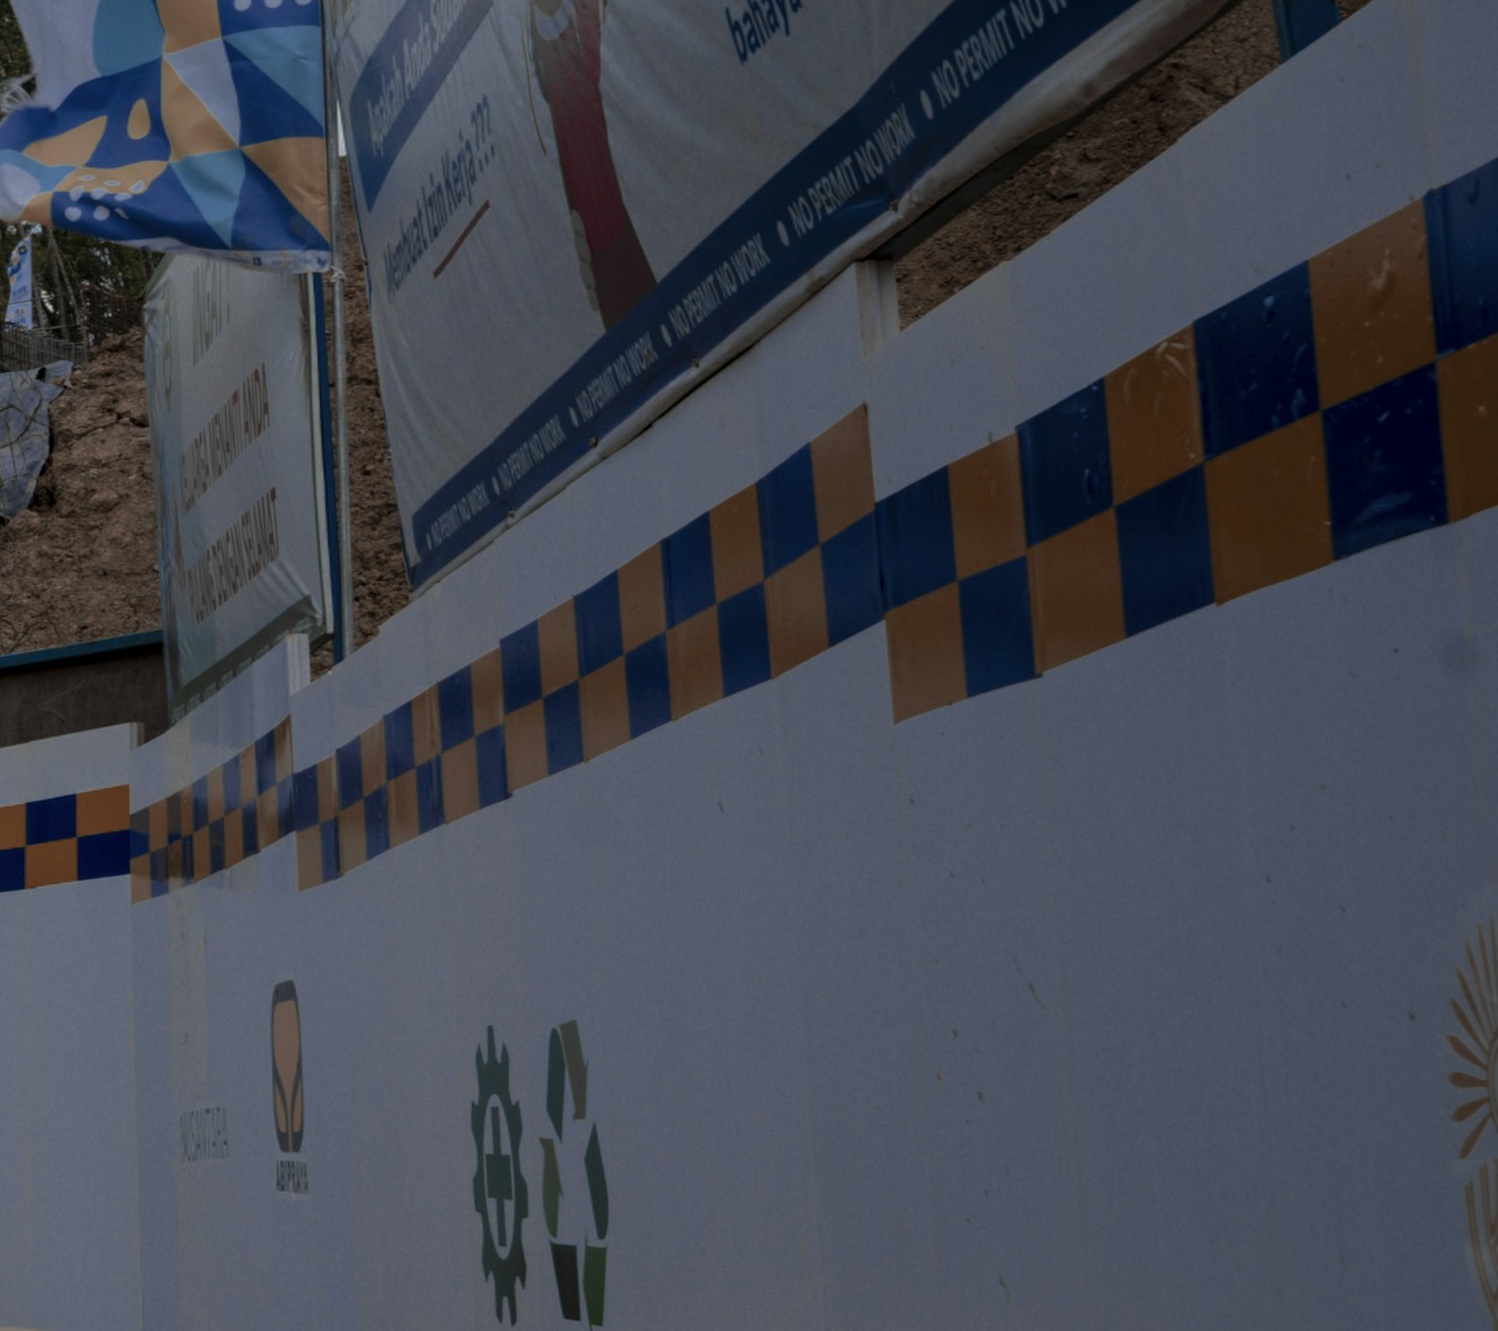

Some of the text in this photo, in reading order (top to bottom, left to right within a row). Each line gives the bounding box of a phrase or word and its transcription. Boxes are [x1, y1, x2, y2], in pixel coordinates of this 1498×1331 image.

[931, 59, 960, 109] NO
[954, 8, 1015, 89] PERMIT
[441, 129, 477, 215] Kerja
[788, 103, 916, 238] NO PERMIT NO WORK
[669, 233, 770, 340] NO PERMIT NO WORK
[243, 362, 270, 449] ANDA
[242, 486, 279, 581] SELAMAT
